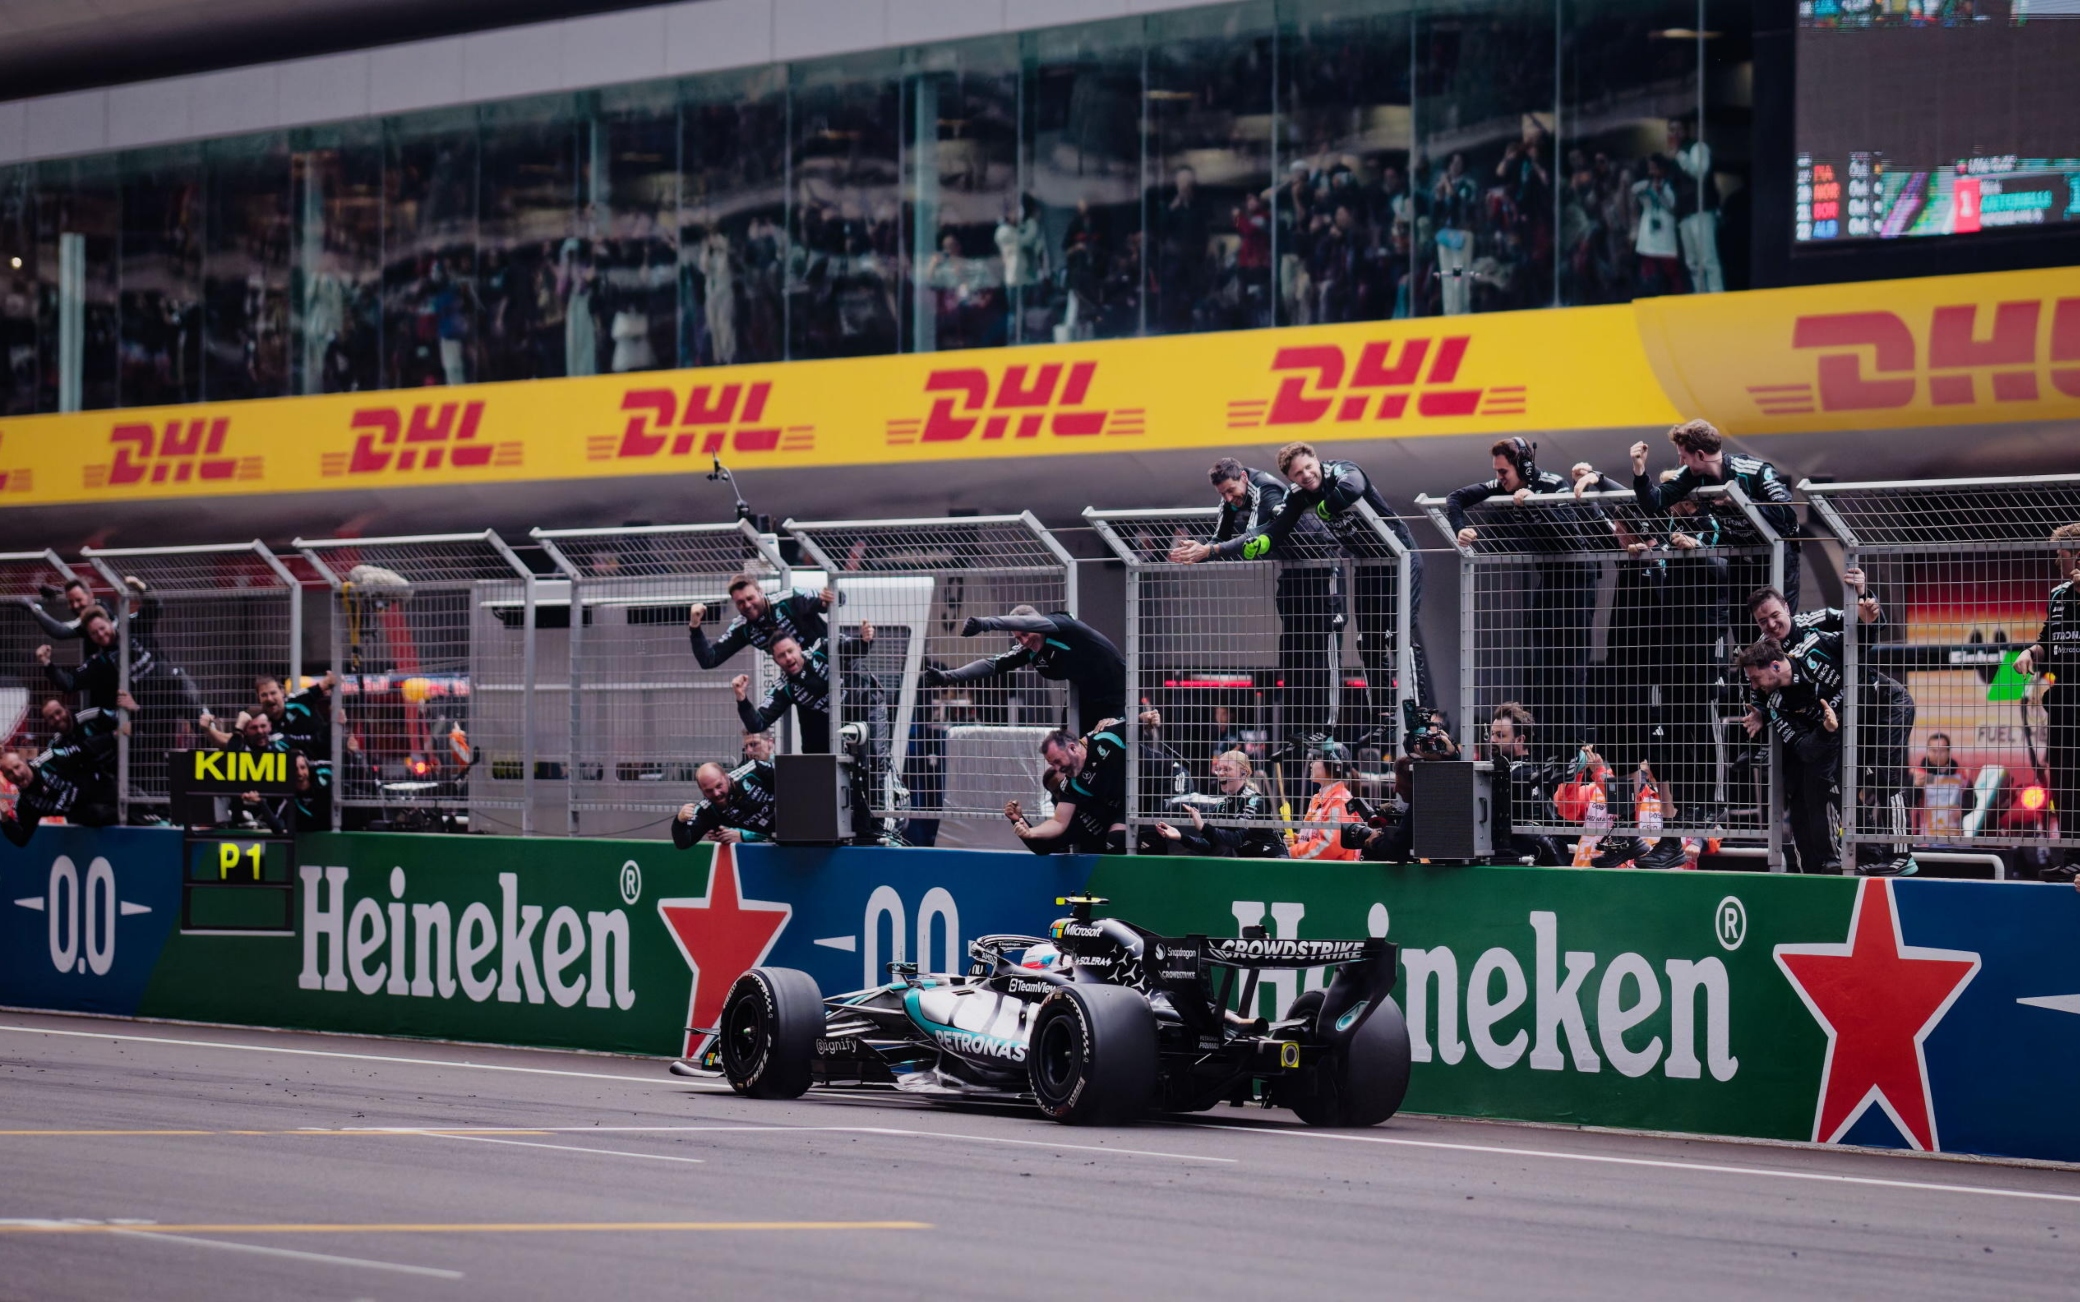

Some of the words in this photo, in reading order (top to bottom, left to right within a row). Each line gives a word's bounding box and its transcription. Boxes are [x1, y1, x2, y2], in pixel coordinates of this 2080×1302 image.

[1266, 335, 1483, 426] DHL
[617, 382, 782, 458] DHL
[920, 361, 1108, 443] DHL
[107, 418, 238, 486] DHL
[348, 401, 494, 474] DHL
[1977, 724, 2015, 743] FUEL
[195, 751, 287, 782] KIMI
[219, 842, 261, 880] P1
[49, 855, 116, 976] 0.0
[1063, 924, 1104, 938] Microsoft
[298, 865, 636, 1011] Heineken
[1167, 947, 1197, 958] Snapdragon
[1220, 939, 1365, 960] CROWDSTRIKE
[1079, 956, 1107, 966] SOLERA
[935, 1029, 1028, 1063] PETRONAS
